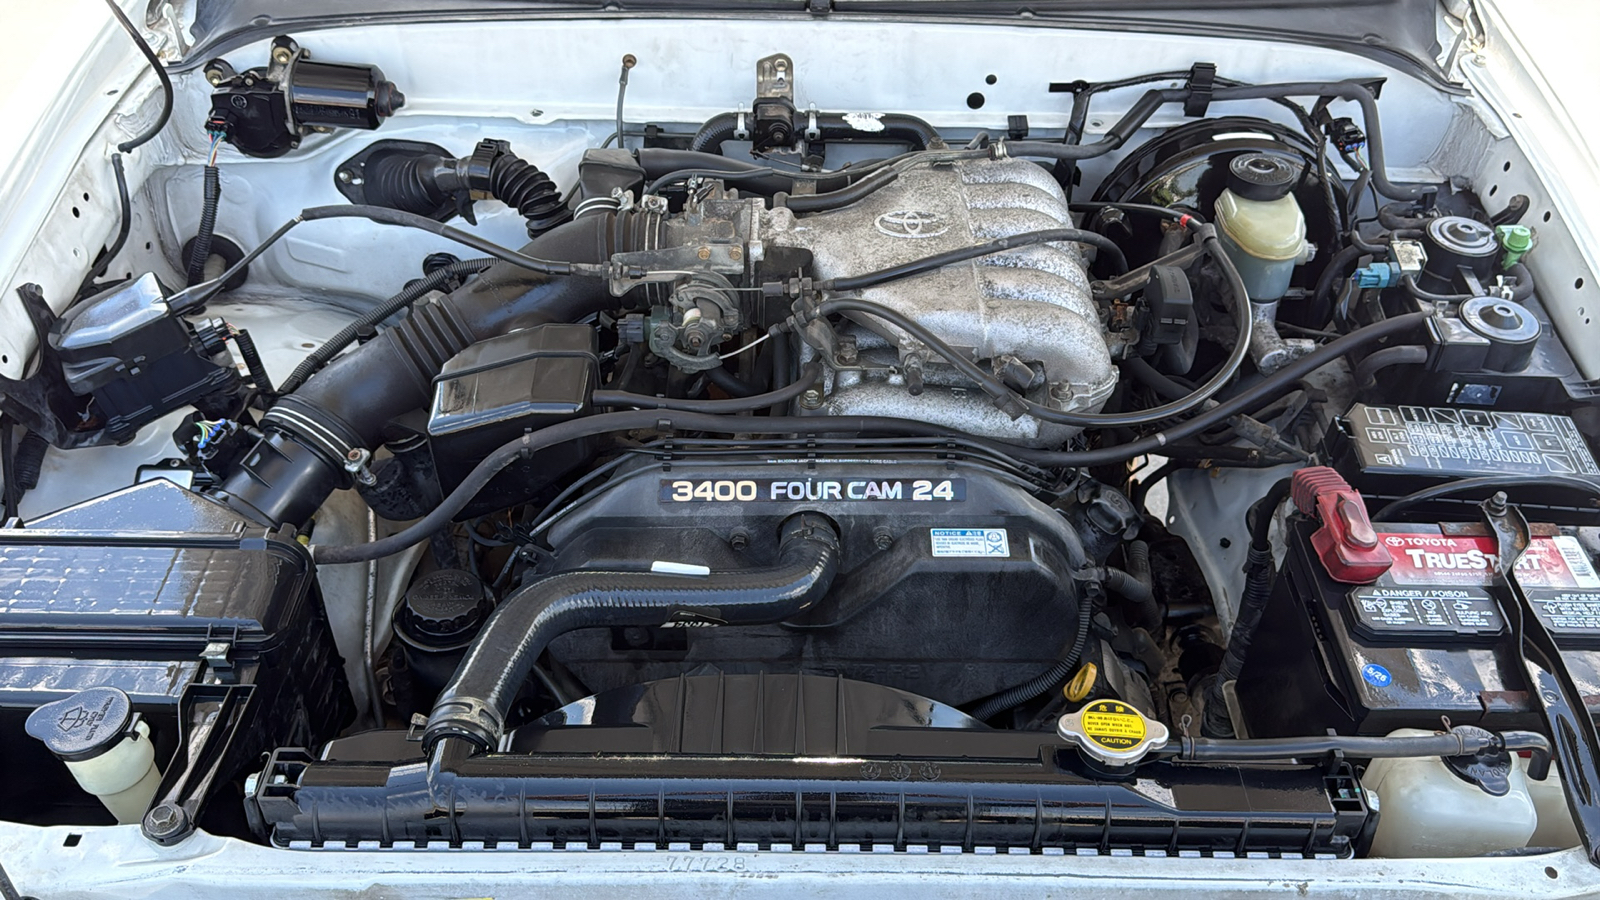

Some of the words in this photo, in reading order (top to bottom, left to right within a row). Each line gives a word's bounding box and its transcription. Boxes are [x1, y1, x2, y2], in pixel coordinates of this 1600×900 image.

[672, 481, 757, 502] 3400
[770, 481, 842, 500] FOUR
[848, 481, 902, 500] CAM
[912, 480, 954, 501] 24
[1405, 537, 1457, 547] TOYOTA
[1405, 549, 1542, 570] TRUESTRT
[1366, 667, 1388, 682] 5/26
[666, 856, 745, 870] 77728
